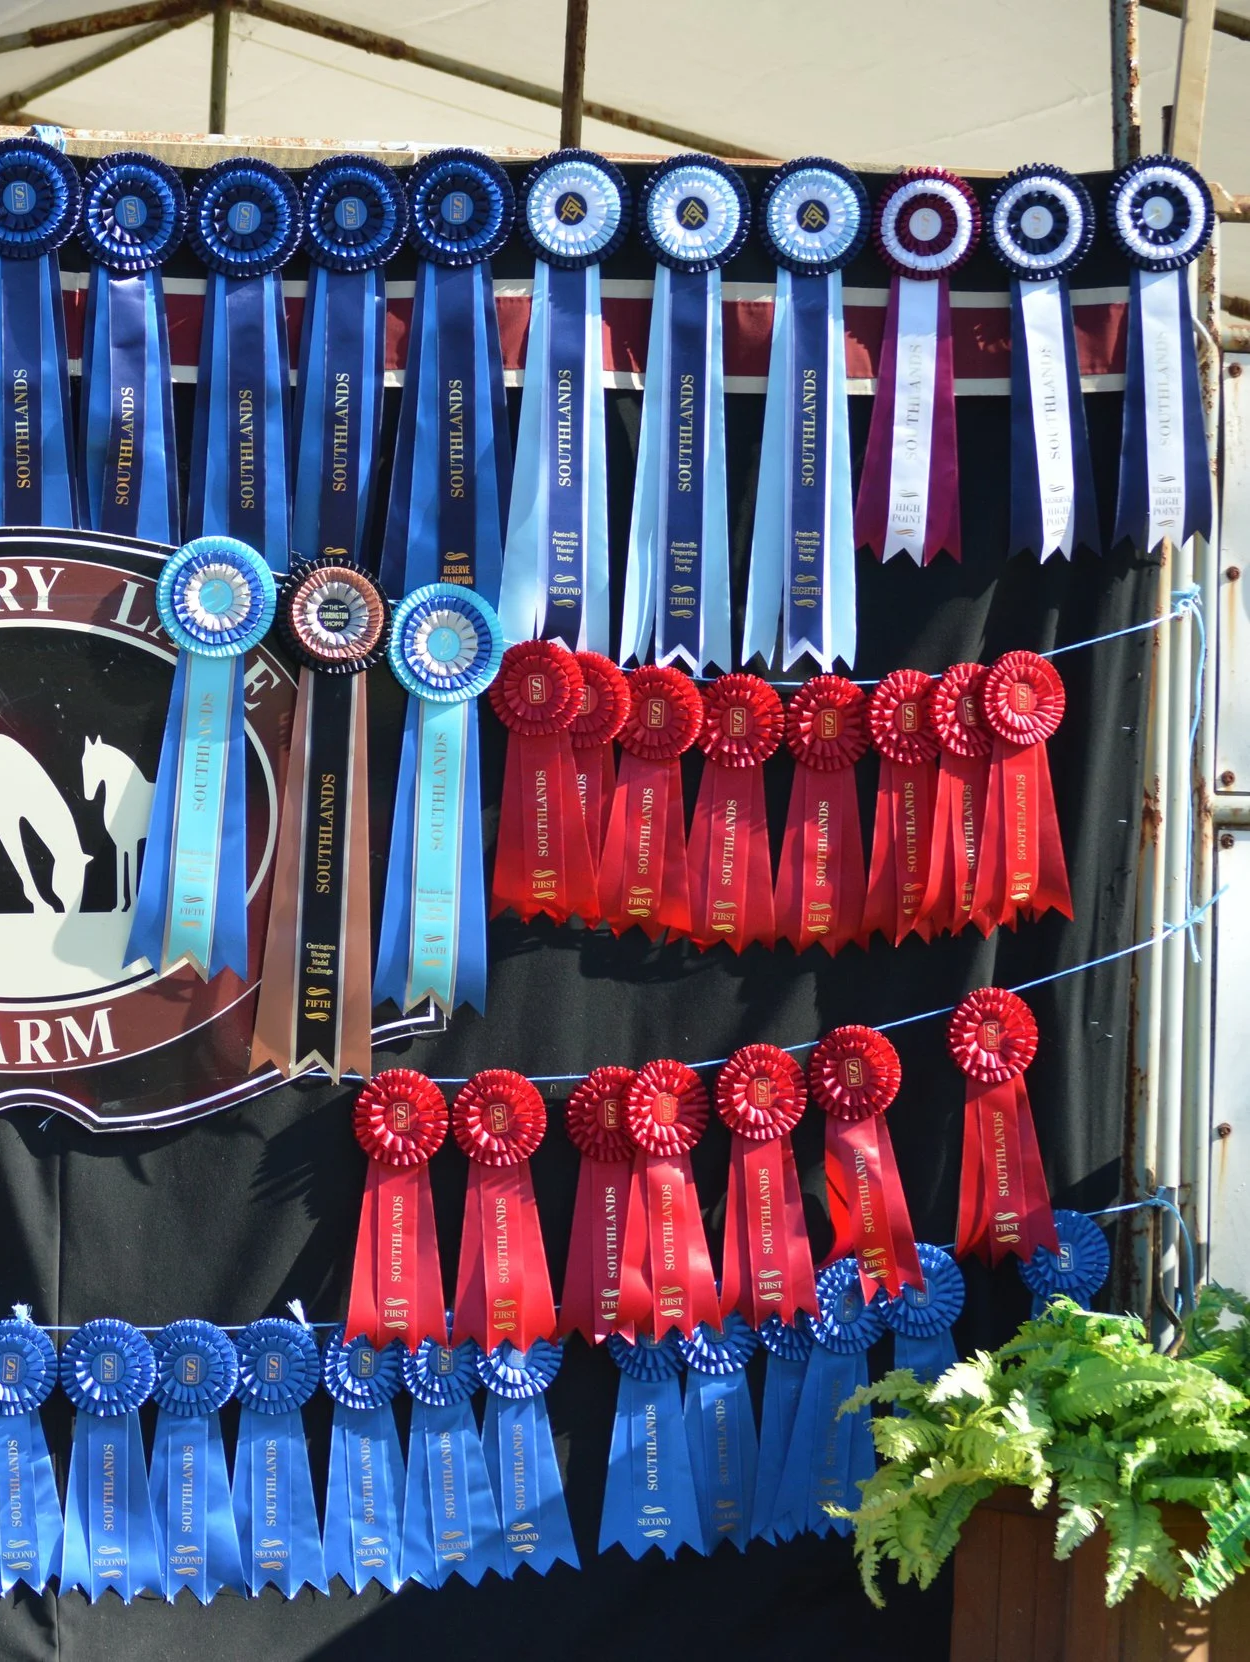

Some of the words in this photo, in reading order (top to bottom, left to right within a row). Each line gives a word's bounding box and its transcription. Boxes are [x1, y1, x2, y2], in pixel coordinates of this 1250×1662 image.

[13, 369, 30, 488] SOUTHLANDS
[115, 387, 134, 505] SOUTHLANDS
[239, 389, 255, 509] SOUTHLANDS
[332, 373, 349, 493] SOUTHLANDS
[449, 380, 464, 498] SOUTHLANDS
[559, 370, 571, 487] SOUTHLANDS
[678, 374, 694, 493] SOUTHLANDS
[801, 369, 816, 487] SOUTHLANDS
[892, 514, 921, 523] POINT
[896, 504, 920, 513] HIGH
[443, 566, 470, 575] RESERVE
[549, 587, 580, 595] SECOND
[556, 555, 573, 563] Derby
[791, 587, 822, 595] EIGHTH
[319, 611, 349, 619] CARRINGTON
[316, 773, 335, 894] SOUTHLANDS
[430, 732, 446, 851] SOUTHLANDS
[536, 770, 547, 857] SOUTHLANDS
[638, 788, 654, 875] SOUTHLANDS
[905, 782, 916, 873] SOUTHLANDS
[963, 785, 976, 870] SOUTHLANDS
[1016, 774, 1026, 861] SOUTHLANDS
[721, 800, 737, 886] SOUTHLANDS
[815, 801, 829, 887] SOUTHLANDS
[629, 897, 652, 906] FIRST
[713, 912, 735, 921] FIRST
[808, 913, 831, 922] FIRST
[1011, 883, 1031, 891] FIRST
[307, 942, 336, 950] Carrington
[307, 966, 333, 975] Challenge
[311, 950, 330, 958] Shoppe
[312, 958, 329, 966] Medal
[306, 1000, 331, 1008] FIFTH
[853, 1147, 875, 1234] SOUTHLANDS
[992, 1111, 1009, 1197] SOUTHLANDS
[391, 1195, 402, 1283] SOUTHLANDS
[496, 1197, 508, 1284] SOUTHLANDS
[606, 1186, 617, 1279] SOUTHLANDS
[661, 1183, 675, 1271] SOUTHLANDS
[759, 1167, 773, 1255] SOUTHLANDS
[995, 1222, 1019, 1232] FIRST
[601, 1299, 619, 1309] FIR
[659, 1298, 684, 1307] FIRST
[758, 1281, 782, 1291] FIRST
[863, 1257, 887, 1268] FIRST
[384, 1309, 408, 1318] FIRST
[493, 1311, 517, 1320] FIRST
[7, 1439, 22, 1527] SOUTHLANDS
[103, 1444, 114, 1531] SOUTHLANDS
[181, 1445, 193, 1533] SOUTHLANDS
[265, 1439, 276, 1527] SOUTHLANDS
[361, 1437, 374, 1524] SOUTHLANDS
[441, 1431, 455, 1518] SOUTHLANDS
[515, 1424, 526, 1511] SOUTHLANDS
[646, 1403, 658, 1491] SOUTHLANDS
[2, 1550, 36, 1561] SECOND
[94, 1557, 127, 1566] SECOND
[255, 1549, 288, 1559] SECOND
[356, 1547, 388, 1557] SECOND
[507, 1533, 539, 1543] SECOND
[637, 1517, 671, 1526] SECOND
